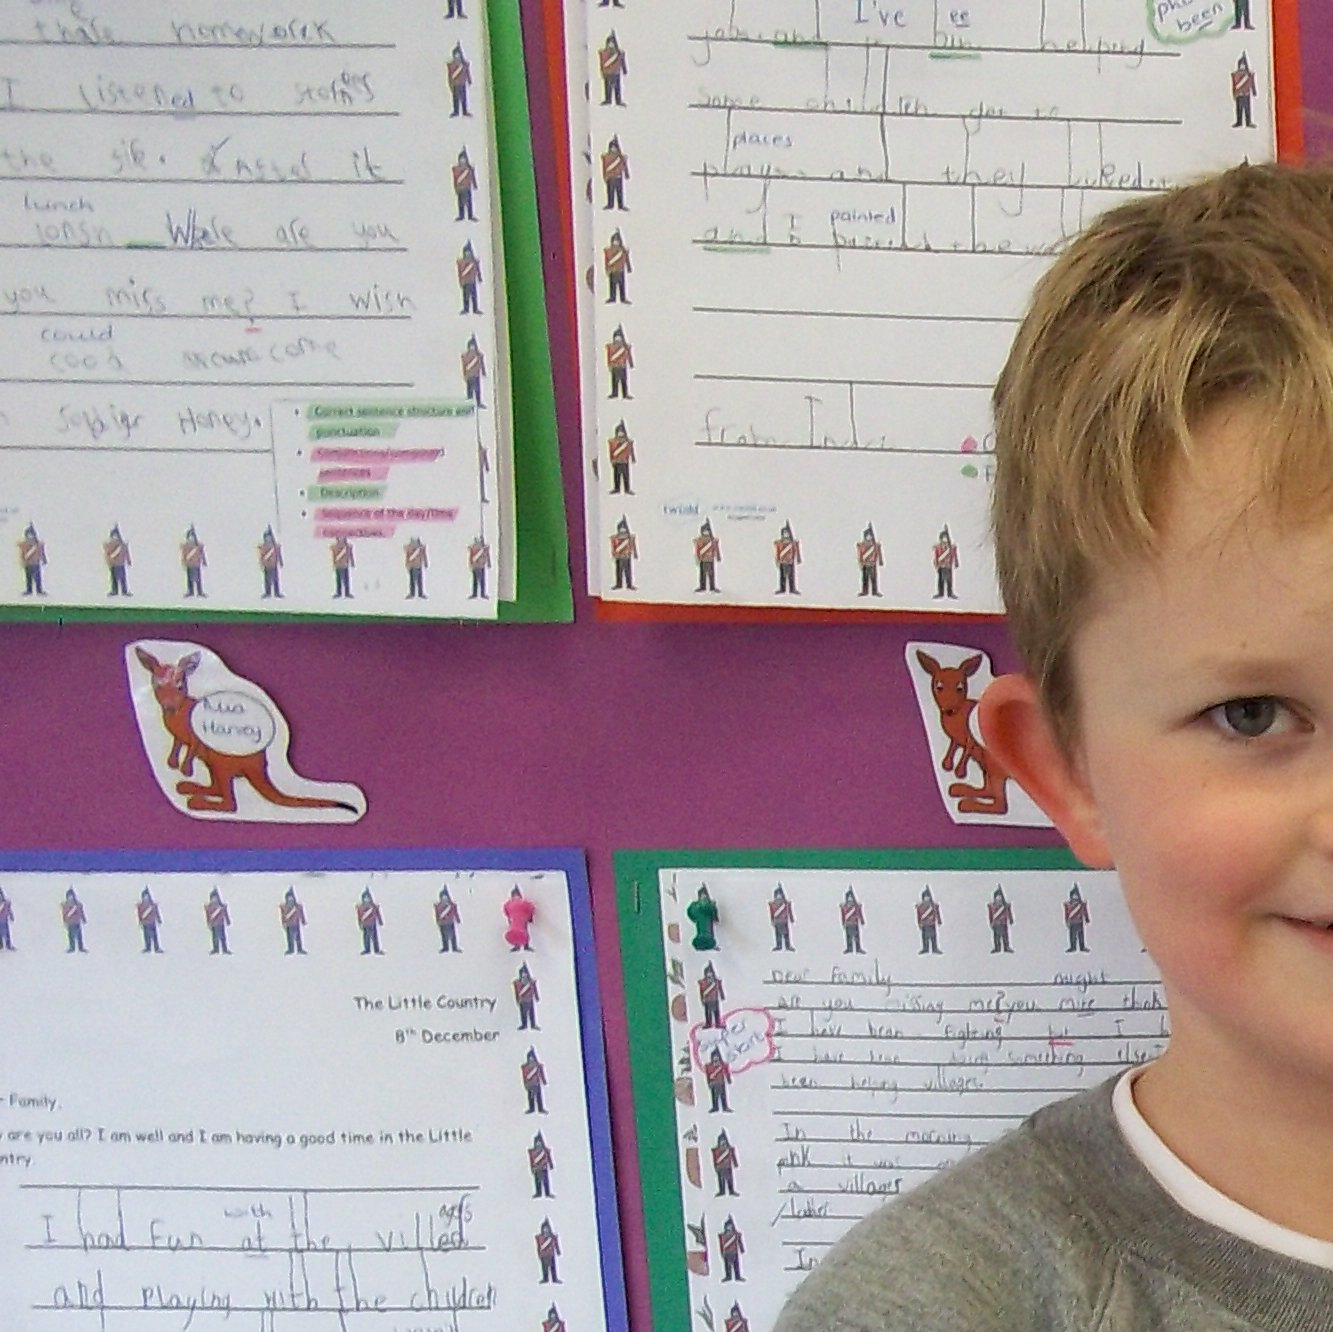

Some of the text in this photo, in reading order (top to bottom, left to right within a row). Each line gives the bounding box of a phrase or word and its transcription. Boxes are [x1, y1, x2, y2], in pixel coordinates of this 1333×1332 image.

[733, 131, 793, 150] places
[24, 193, 94, 213] lunch
[830, 206, 896, 228] painted
[41, 325, 113, 343] could
[353, 994, 497, 1013] The Little Country
[422, 1028, 500, 1044] December
[8, 1127, 473, 1150] are you all? I am well and I am having a good time in the Little
[42, 1214, 58, 1244] I
